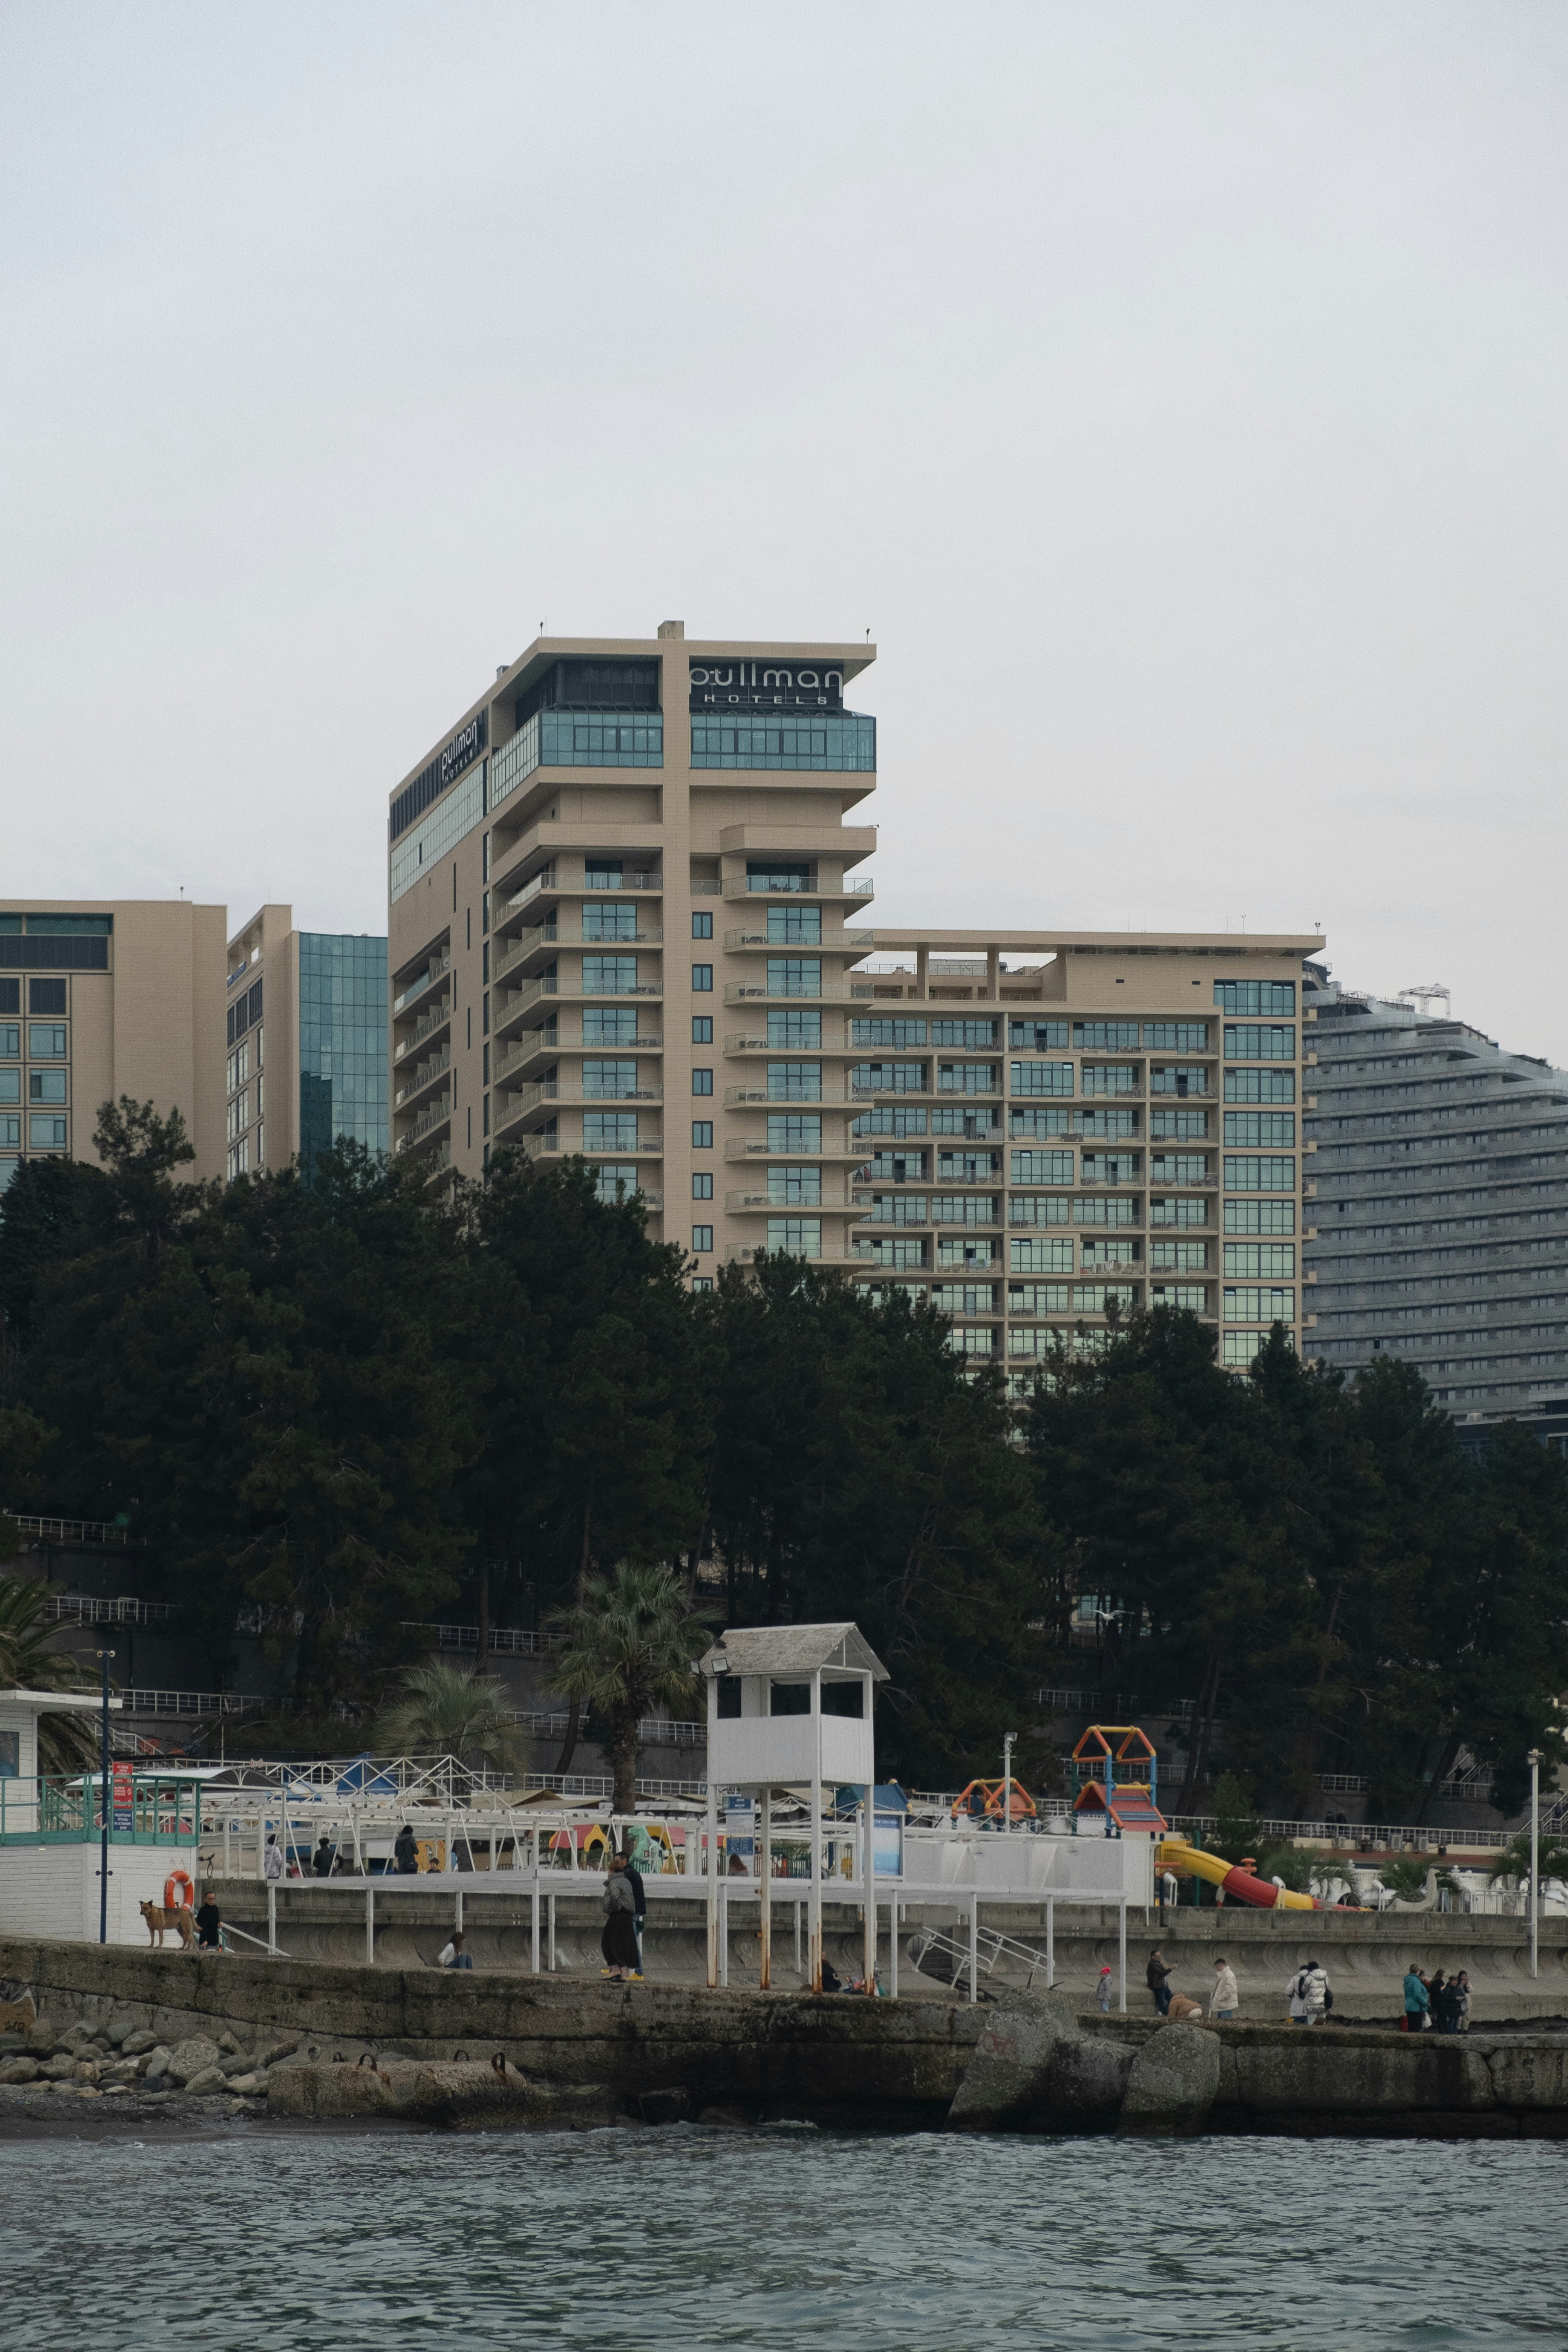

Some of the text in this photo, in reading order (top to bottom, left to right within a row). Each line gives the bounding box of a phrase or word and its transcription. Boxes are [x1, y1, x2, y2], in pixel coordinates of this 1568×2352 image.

[689, 662, 843, 698] pullman
[704, 694, 827, 705] HOTELS
[442, 721, 477, 781] pullman
[445, 749, 473, 782] HOTELS
